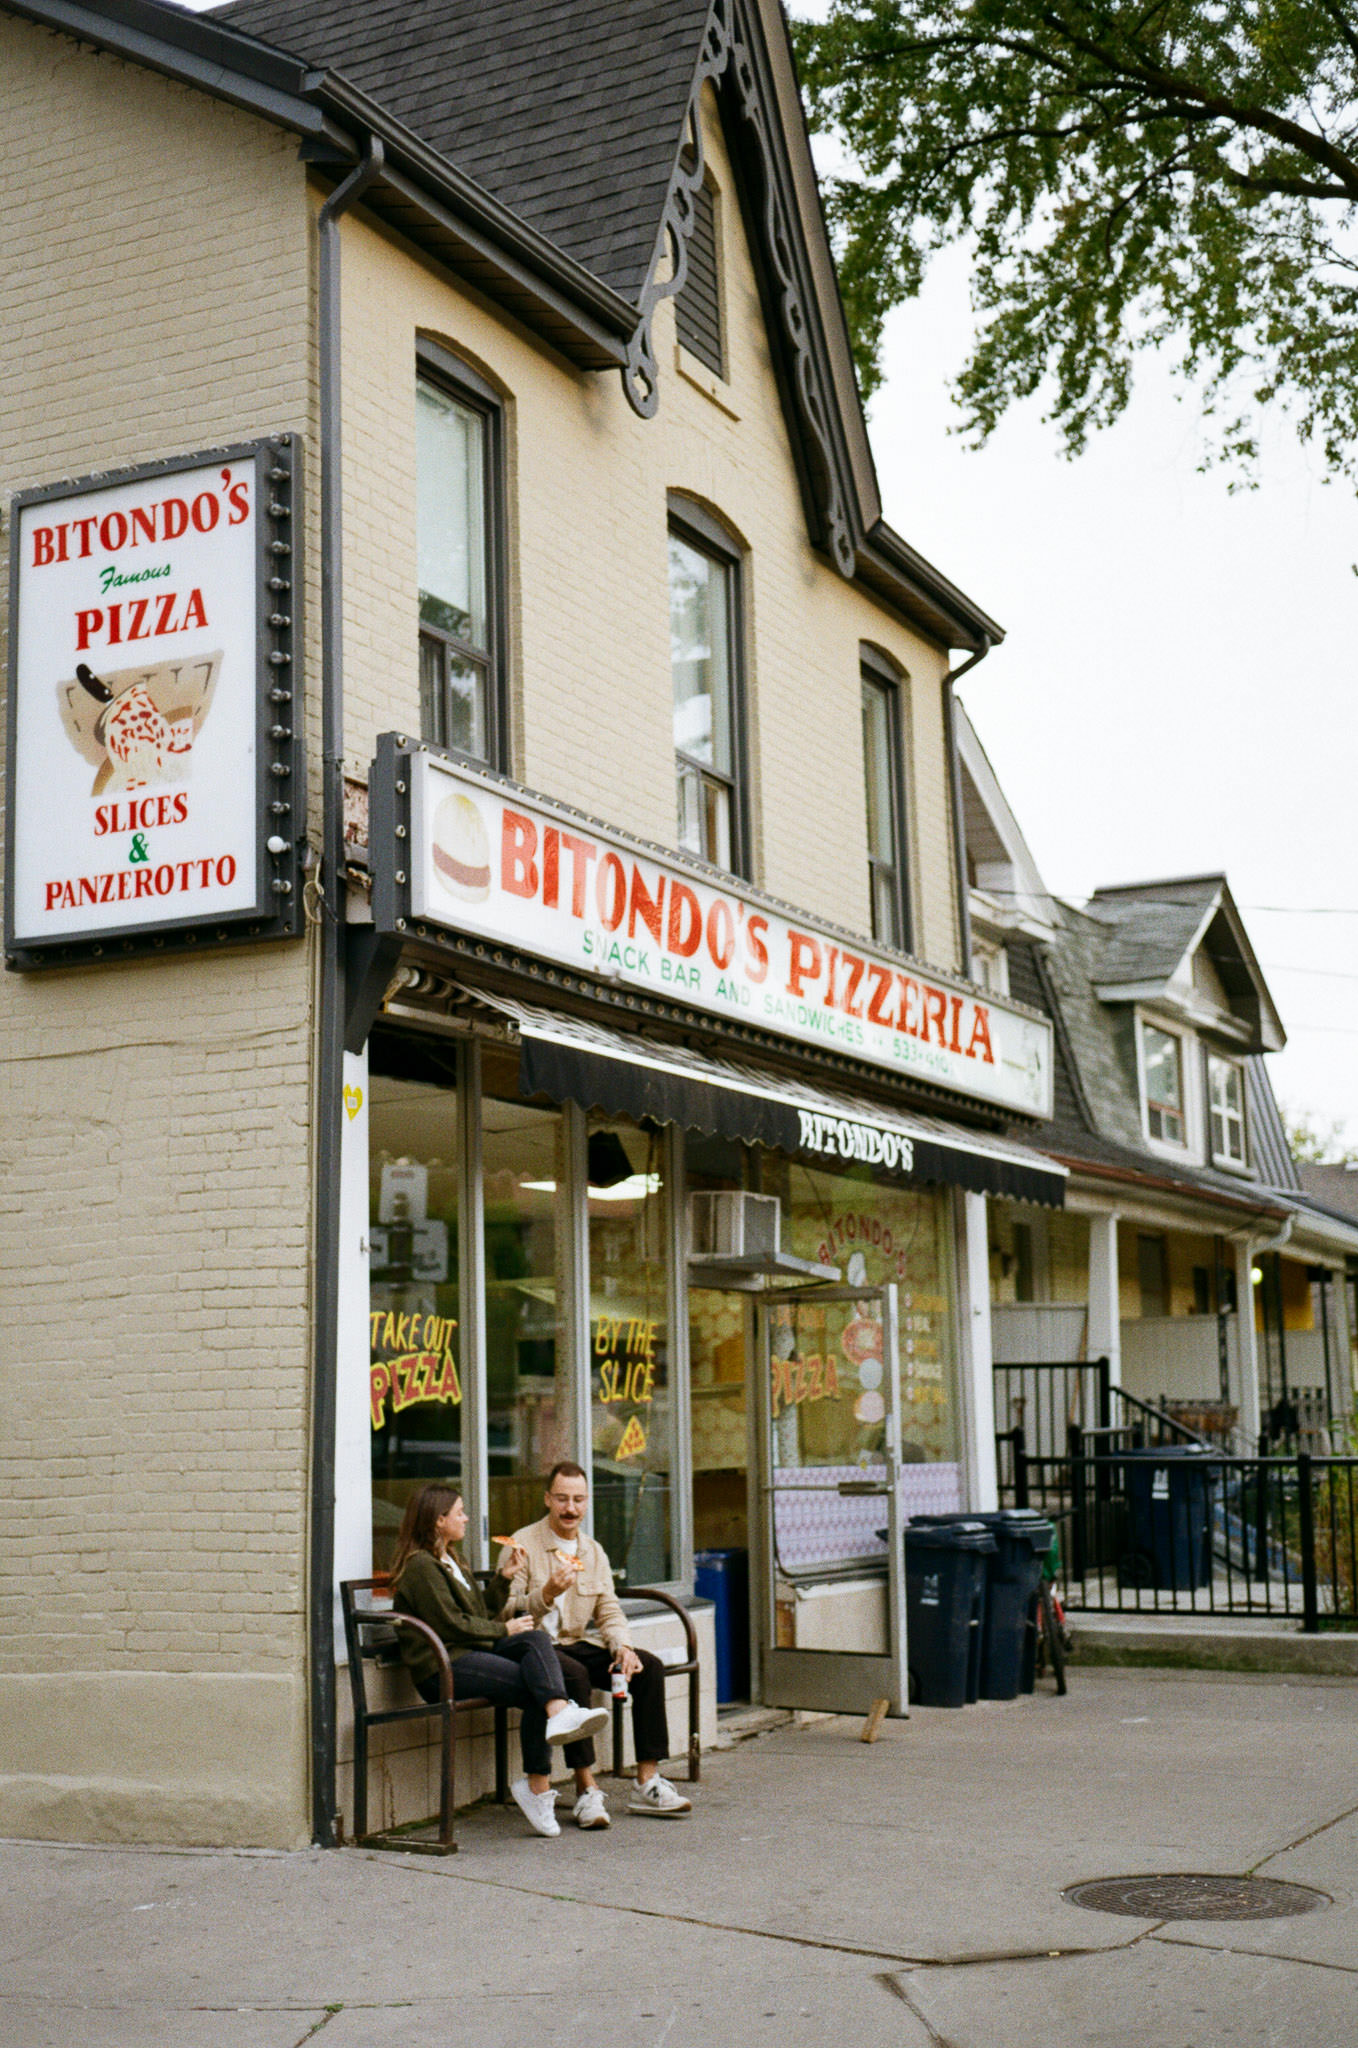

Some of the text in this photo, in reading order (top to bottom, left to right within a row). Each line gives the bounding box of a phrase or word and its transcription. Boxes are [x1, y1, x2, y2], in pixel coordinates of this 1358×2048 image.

[32, 468, 250, 567] BITONDO'S
[99, 562, 172, 595] Famous
[75, 588, 209, 651] PIZZA
[94, 792, 189, 837] SLICES
[128, 832, 150, 864] &
[44, 855, 237, 911] PANZEROTTO
[501, 807, 995, 1065] BITONDO'S PIZZERIA
[660, 957, 702, 992] BAR
[715, 977, 752, 1007] AND
[370, 1311, 458, 1353] TAKE OUT
[595, 1314, 658, 1359] BY THE
[370, 1348, 463, 1431] PIZZA
[600, 1359, 656, 1405] SLICE
[771, 1351, 841, 1419] PIZZA
